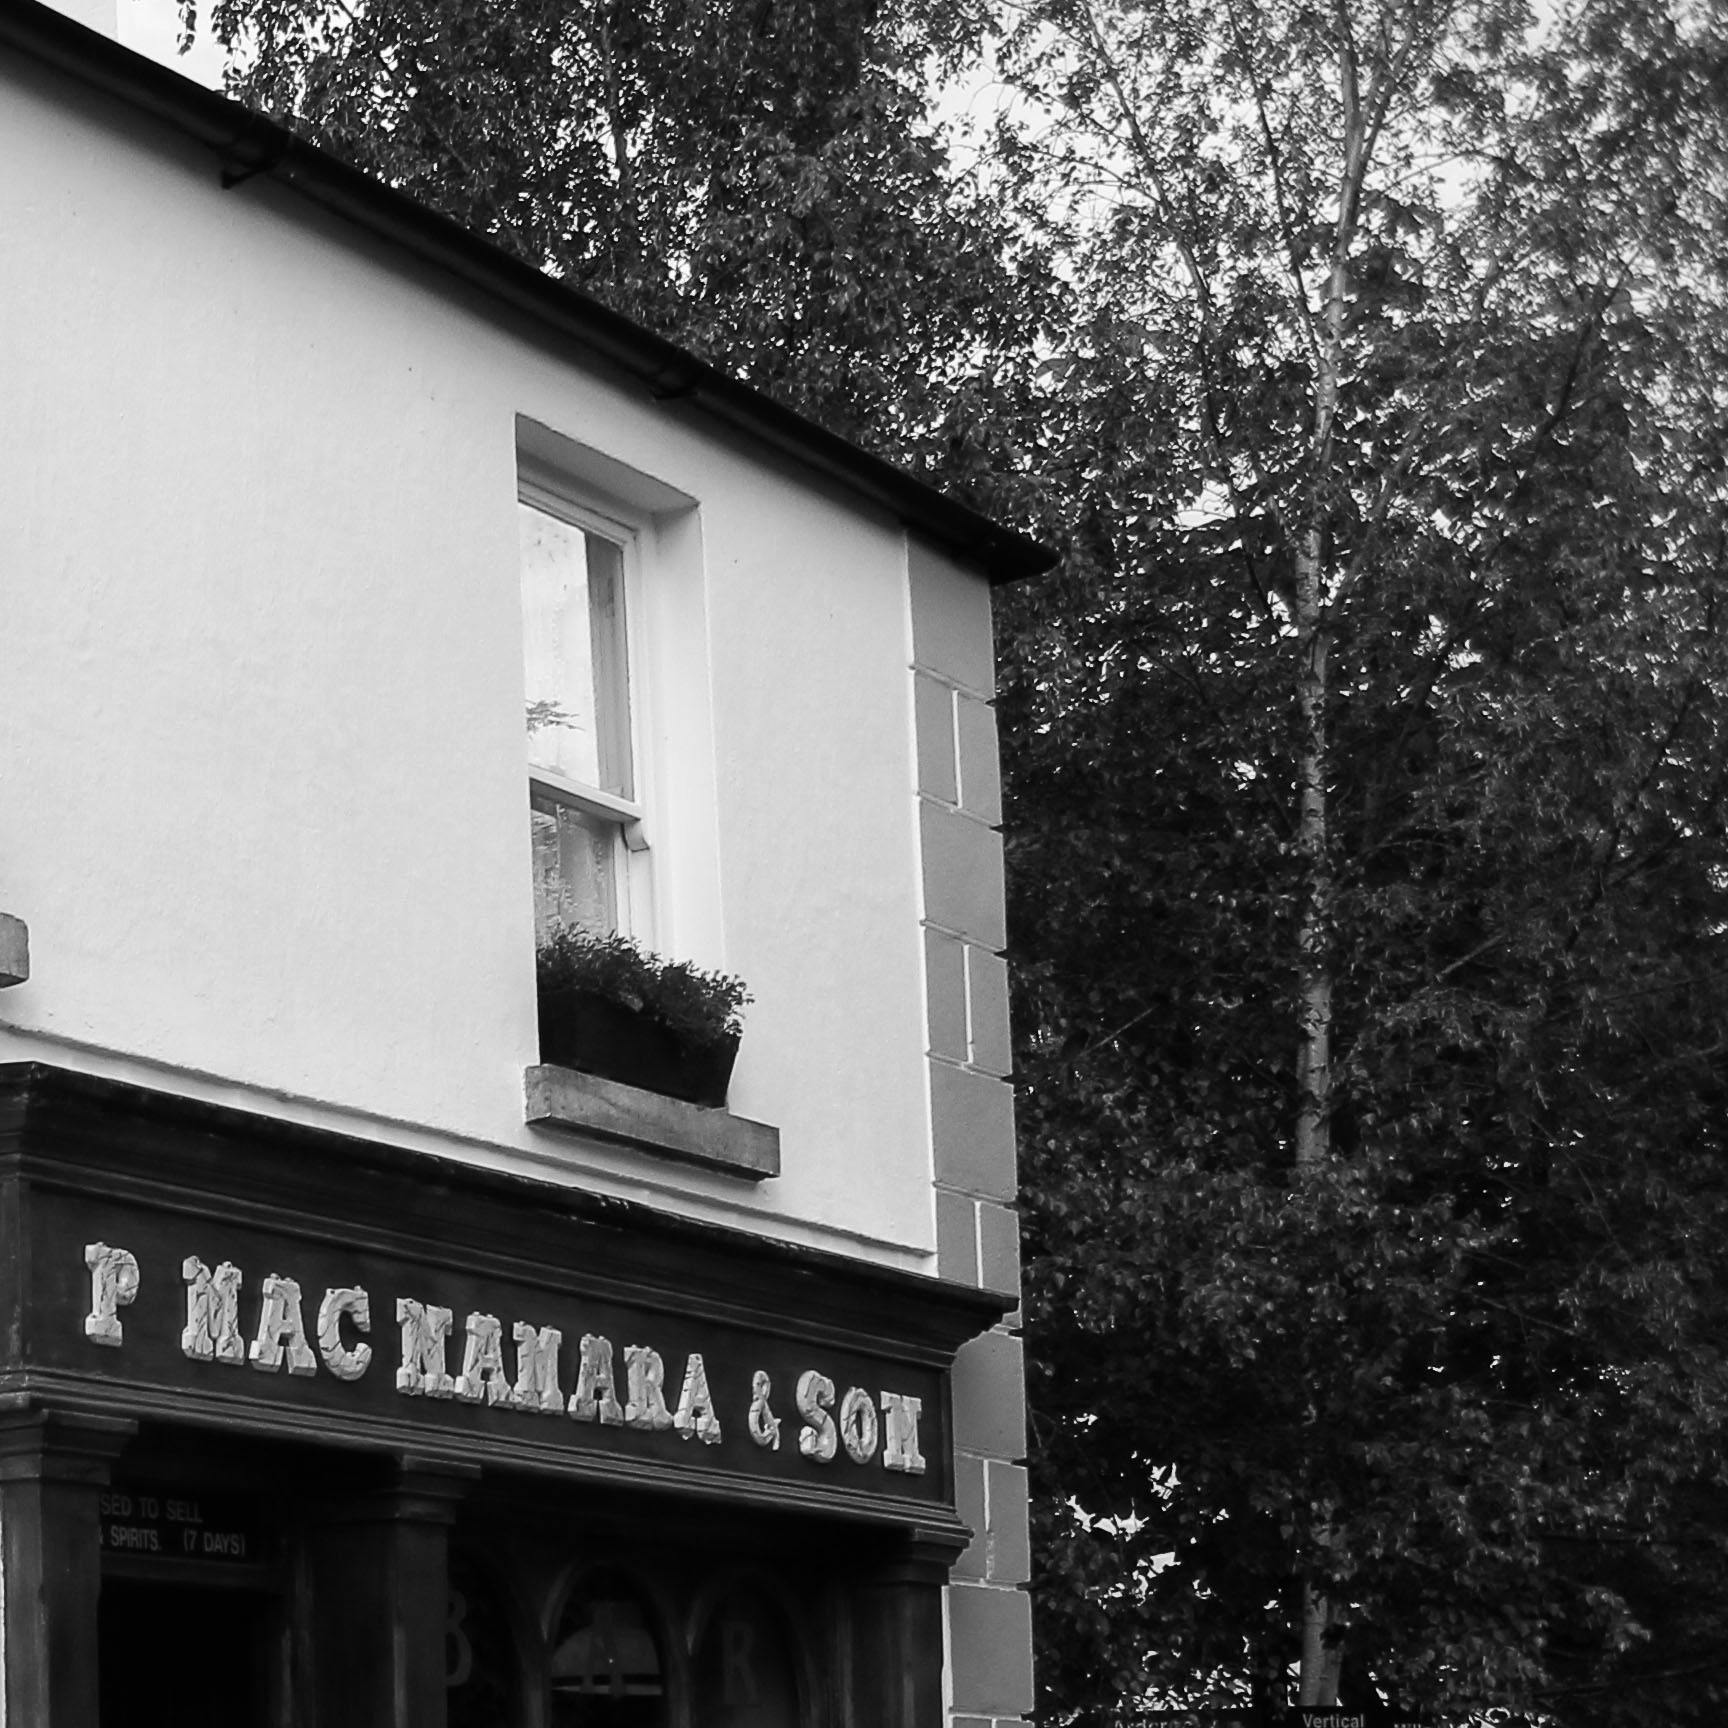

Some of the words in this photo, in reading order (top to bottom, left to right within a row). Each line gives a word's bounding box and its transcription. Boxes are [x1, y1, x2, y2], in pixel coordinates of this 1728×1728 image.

[84, 1241, 141, 1347] P
[181, 1253, 373, 1382] MAC
[396, 1297, 723, 1445] NAMARA
[748, 1369, 782, 1451] &
[796, 1368, 927, 1475] SON
[139, 1497, 159, 1520] TO
[166, 1500, 203, 1523] SELL
[204, 1531, 246, 1557] DAYS)
[1302, 1713, 1365, 1728] Vertical
